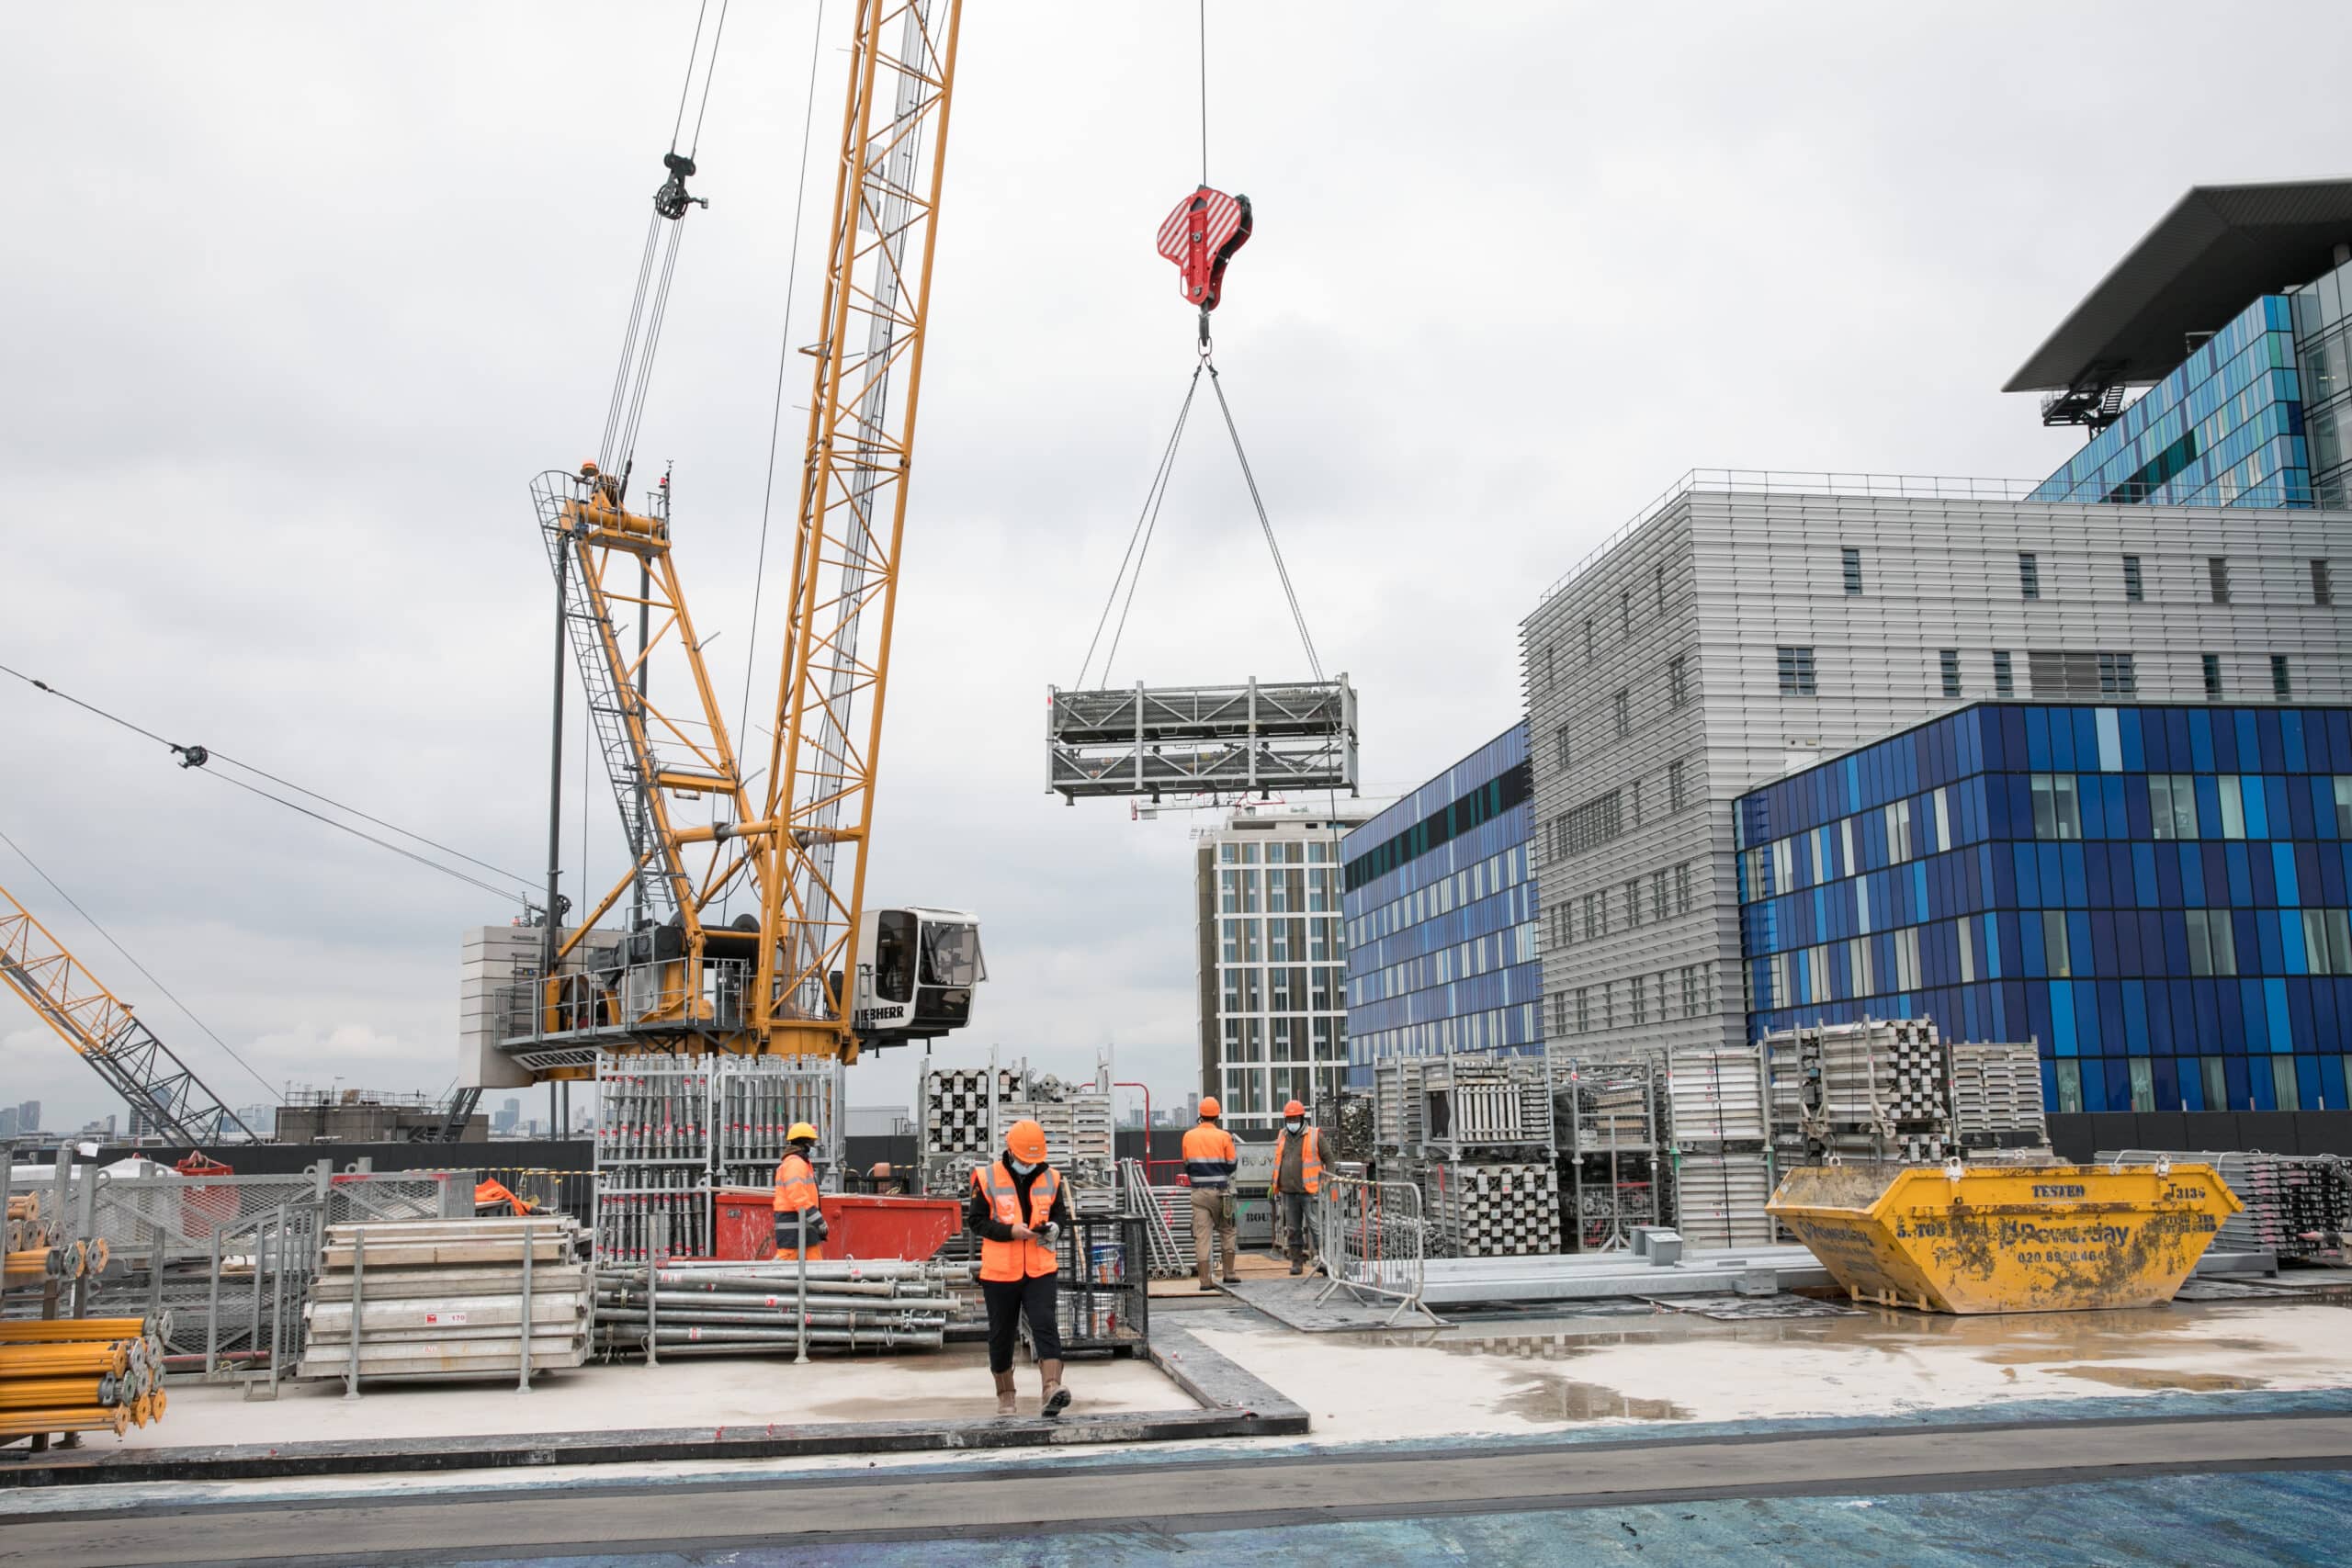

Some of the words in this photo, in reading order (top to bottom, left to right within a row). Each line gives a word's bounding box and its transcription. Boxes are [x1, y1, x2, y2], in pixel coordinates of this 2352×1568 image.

[854, 1006, 904, 1021] LIEBHERR
[521, 1049, 597, 1067] LIEBHERR
[2032, 1184, 2085, 1198] TESTED
[2046, 1250, 2078, 1262] 890
